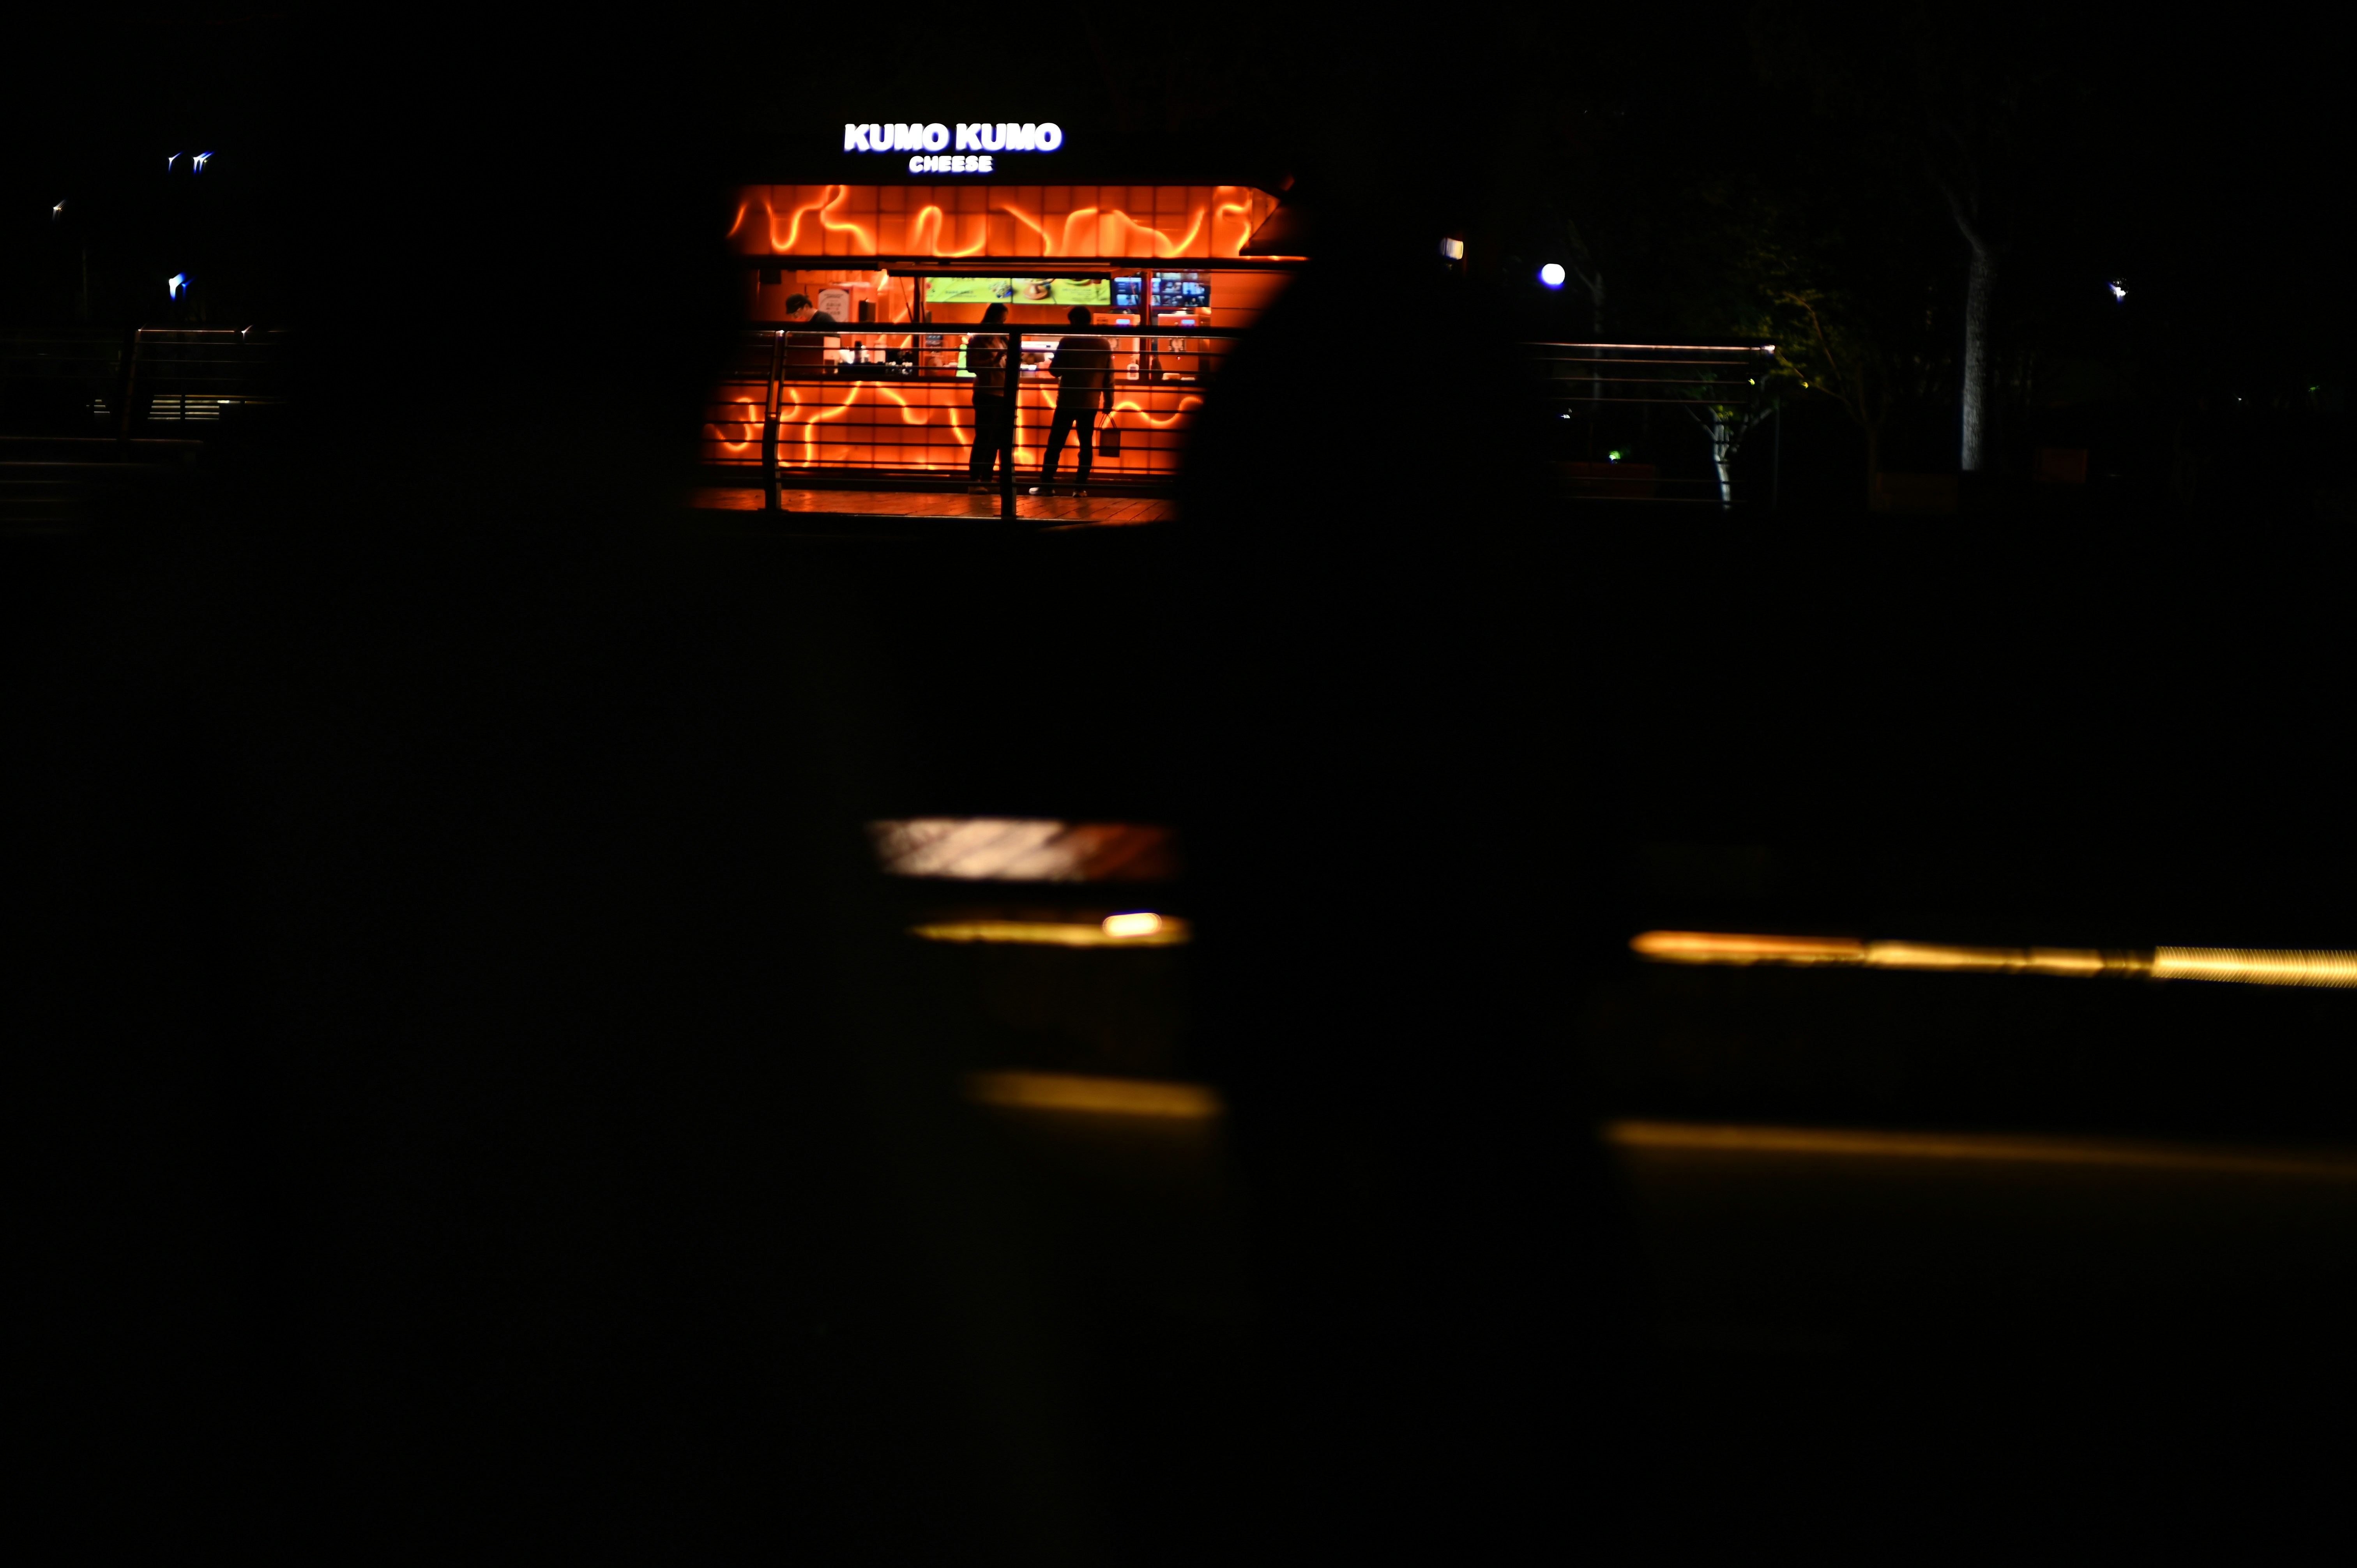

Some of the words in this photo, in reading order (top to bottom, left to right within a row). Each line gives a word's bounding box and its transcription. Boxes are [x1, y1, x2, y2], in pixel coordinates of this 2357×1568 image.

[845, 123, 949, 151] KUMO
[956, 123, 1062, 151] KUMO
[909, 155, 993, 173] CHEESE
